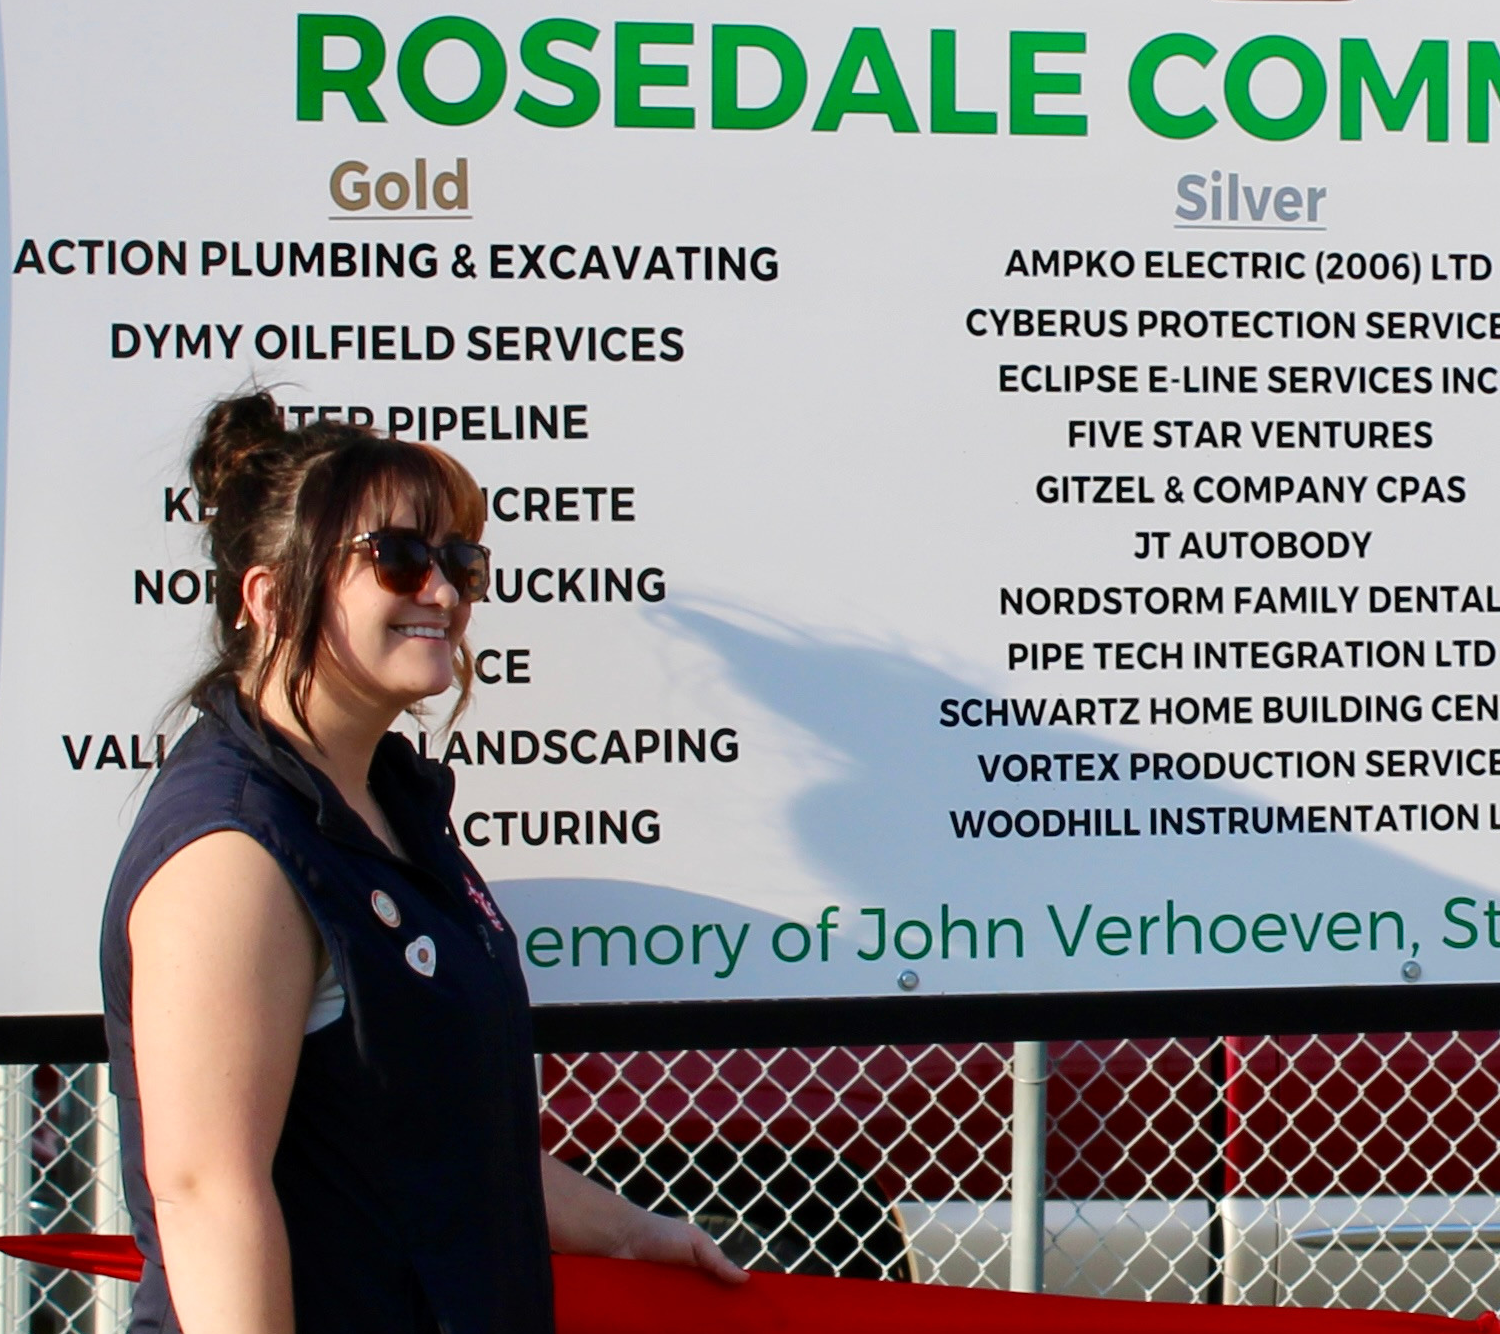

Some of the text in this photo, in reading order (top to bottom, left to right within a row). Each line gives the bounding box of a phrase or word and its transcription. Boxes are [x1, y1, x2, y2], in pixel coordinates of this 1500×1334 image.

[296, 13, 1088, 136] ROSEDALE
[330, 158, 468, 211] Gold
[1174, 170, 1327, 223] Silver
[13, 239, 778, 281] ACTION PLUMBING & EXCAVATING
[1005, 250, 1492, 284] AMPKO ELECTRIC (2006) LTD
[966, 309, 1128, 337] CYBERUS
[1139, 310, 1355, 338] PROTECTION
[112, 323, 684, 362] DYMY OILFIELD SERVICES
[1000, 365, 1497, 394] ECLIPSE E-LINE SERVICES INC
[388, 405, 589, 441] PIPELINE
[1069, 421, 1432, 448] FIVE STAR VENTURES
[482, 487, 636, 522] CRETE
[1036, 476, 1465, 503] GITZEL & COMPANY CPAS
[1134, 531, 1372, 559] JT AUTOBODY
[483, 568, 666, 603] UCKING
[1001, 587, 1223, 615] NORDSTORM
[1235, 586, 1359, 614] FAMILY
[1009, 640, 1496, 670] PIPE TECH INTEGRATION LTD
[940, 698, 1140, 727] SCHWARTZ
[1151, 697, 1252, 724] HOME
[1264, 695, 1422, 723] BUILDING
[419, 730, 740, 766] LANDSCAPING
[978, 753, 1120, 782] VORTEX
[1130, 751, 1355, 781] PRODUCTION
[450, 810, 661, 847] CTURING
[949, 809, 1140, 838] WOODHILL
[1150, 804, 1478, 835] INSTRUMENTATION
[527, 923, 751, 978] emory
[772, 906, 839, 963] of
[857, 904, 1023, 961] John
[1047, 900, 1419, 958] Verhoeven,
